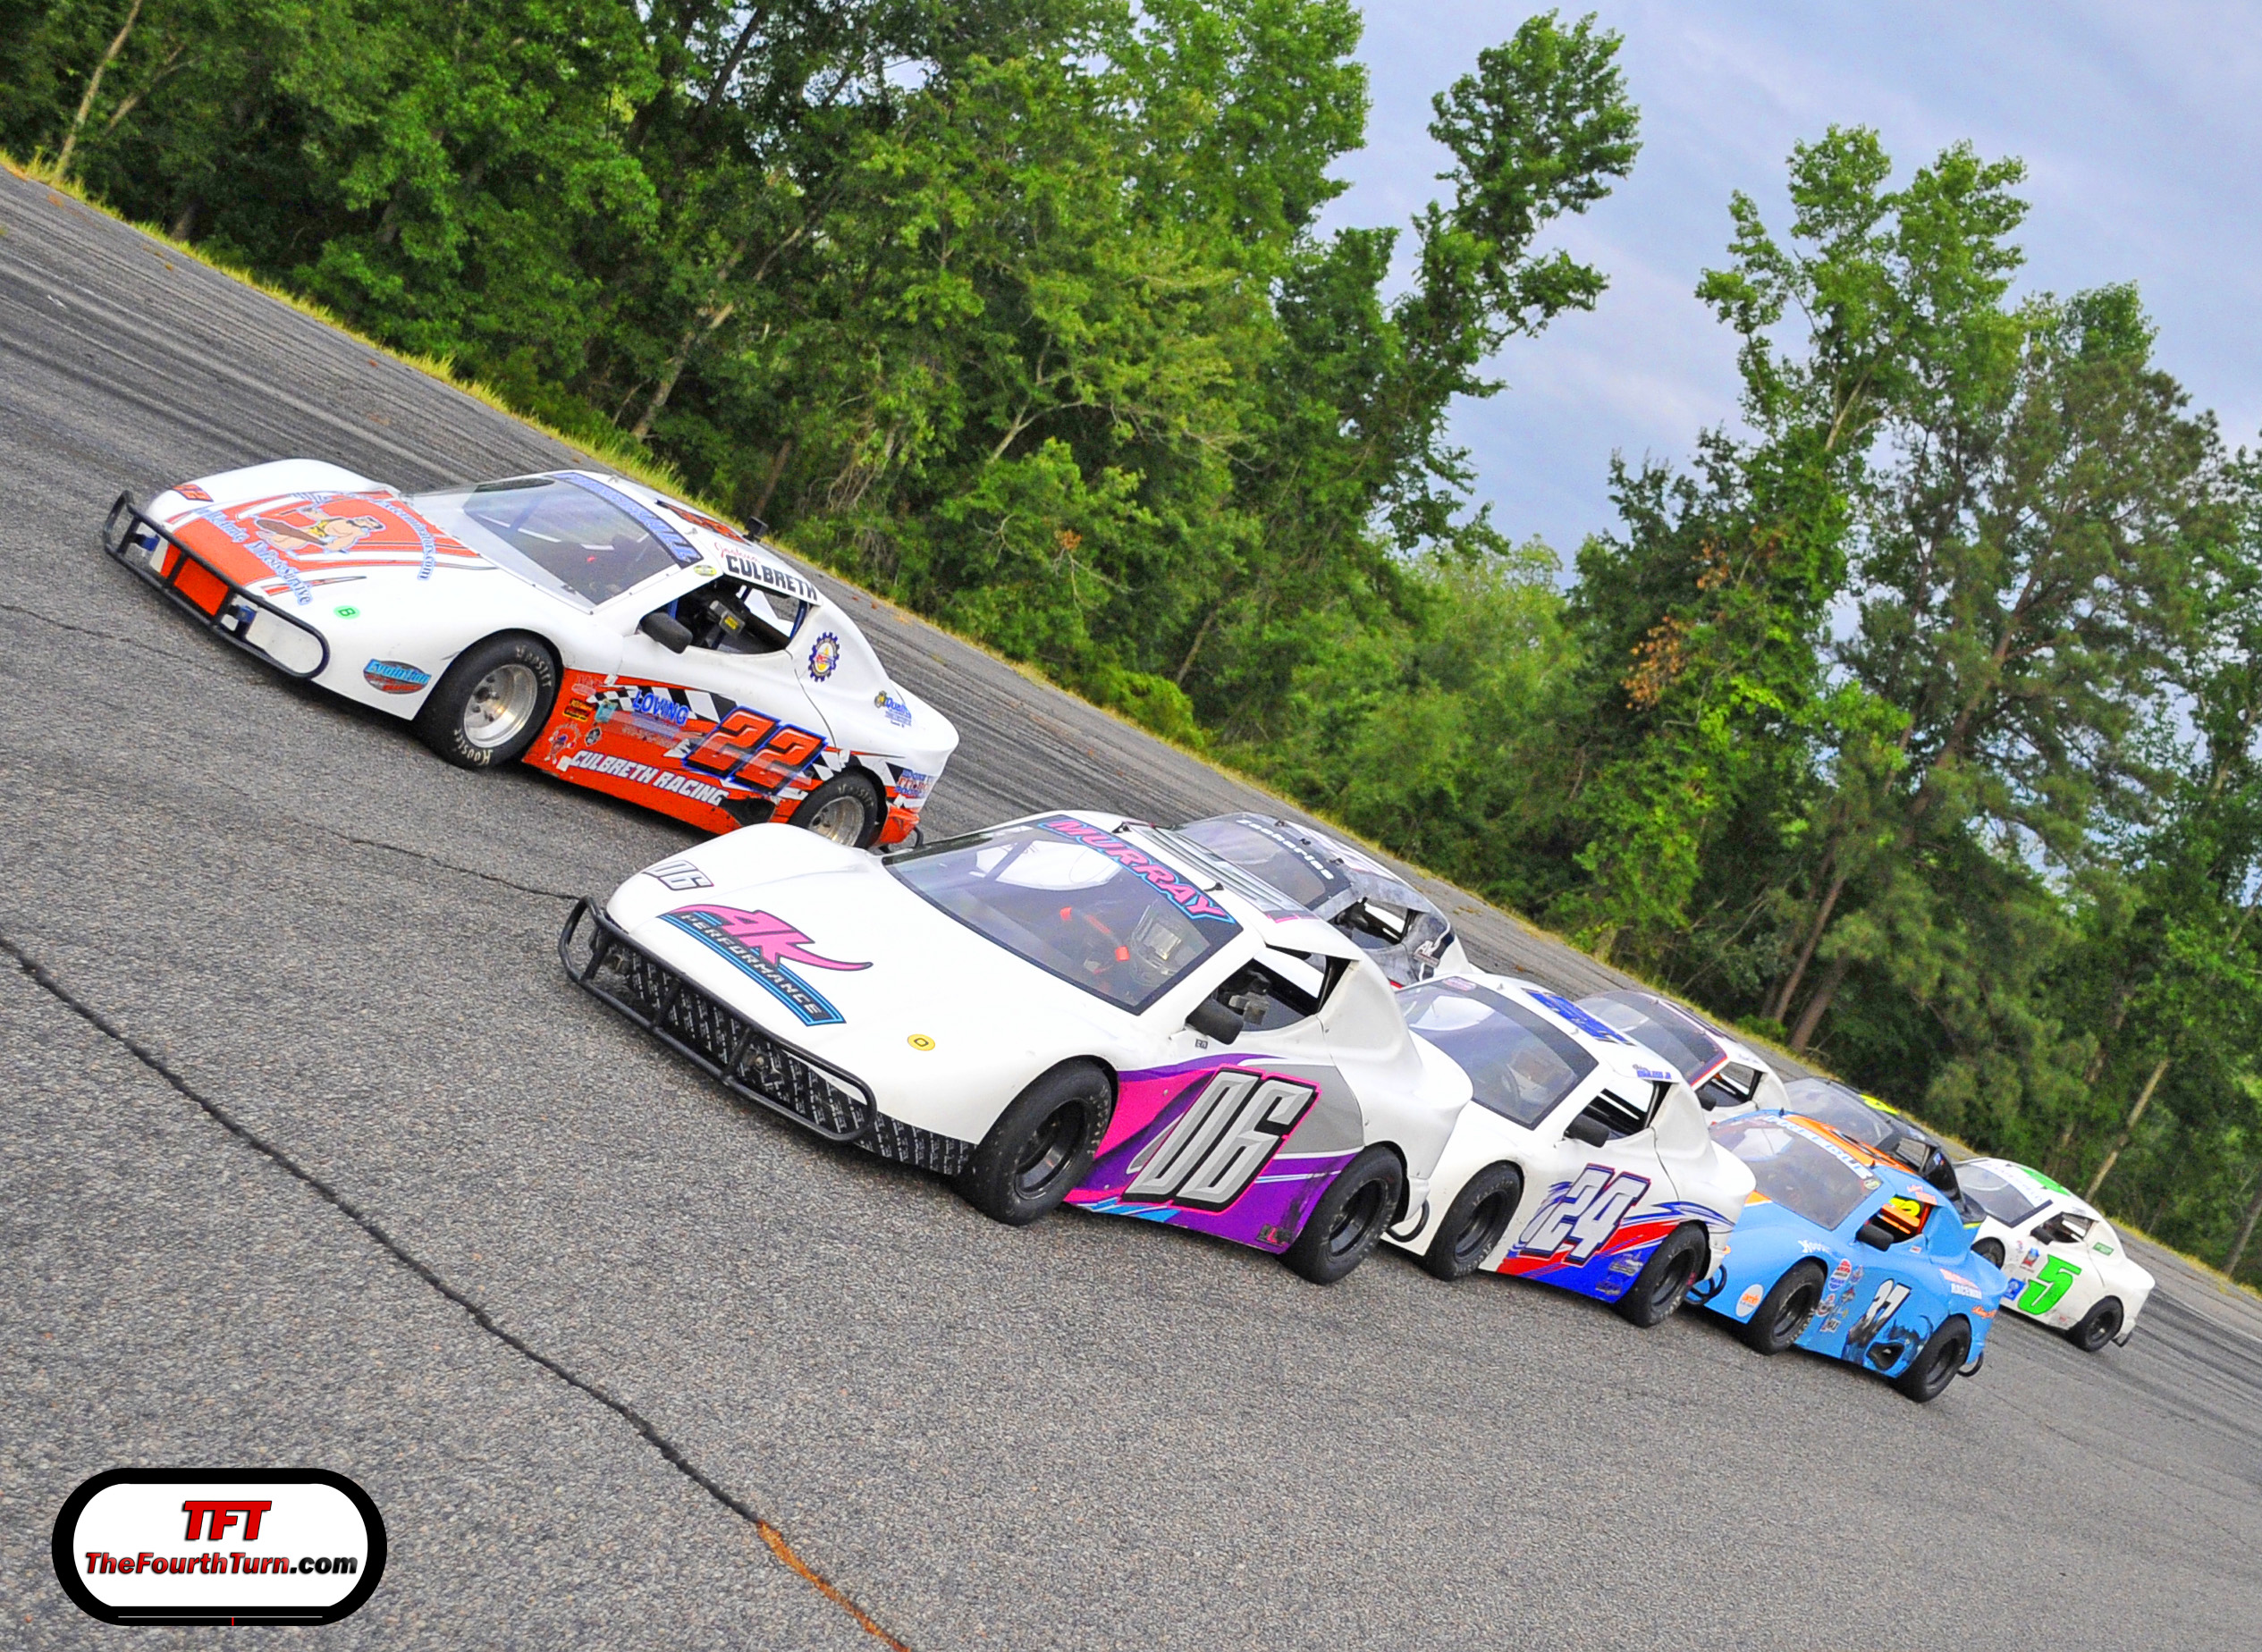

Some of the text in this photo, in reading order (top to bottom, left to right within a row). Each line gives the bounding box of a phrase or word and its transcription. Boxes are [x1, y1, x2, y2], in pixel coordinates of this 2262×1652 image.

[725, 554, 818, 602] CULBRETH
[632, 689, 690, 726] LOVING
[570, 749, 730, 806] CULBRETH RACING
[682, 705, 828, 796] 22
[640, 859, 714, 891] 06
[1041, 819, 1234, 922] MURRAY
[679, 914, 823, 1016] PERFORMANCE
[1121, 1068, 1319, 1212] 06
[1516, 1164, 1651, 1267] 24
[2017, 1253, 2082, 1316] 5
